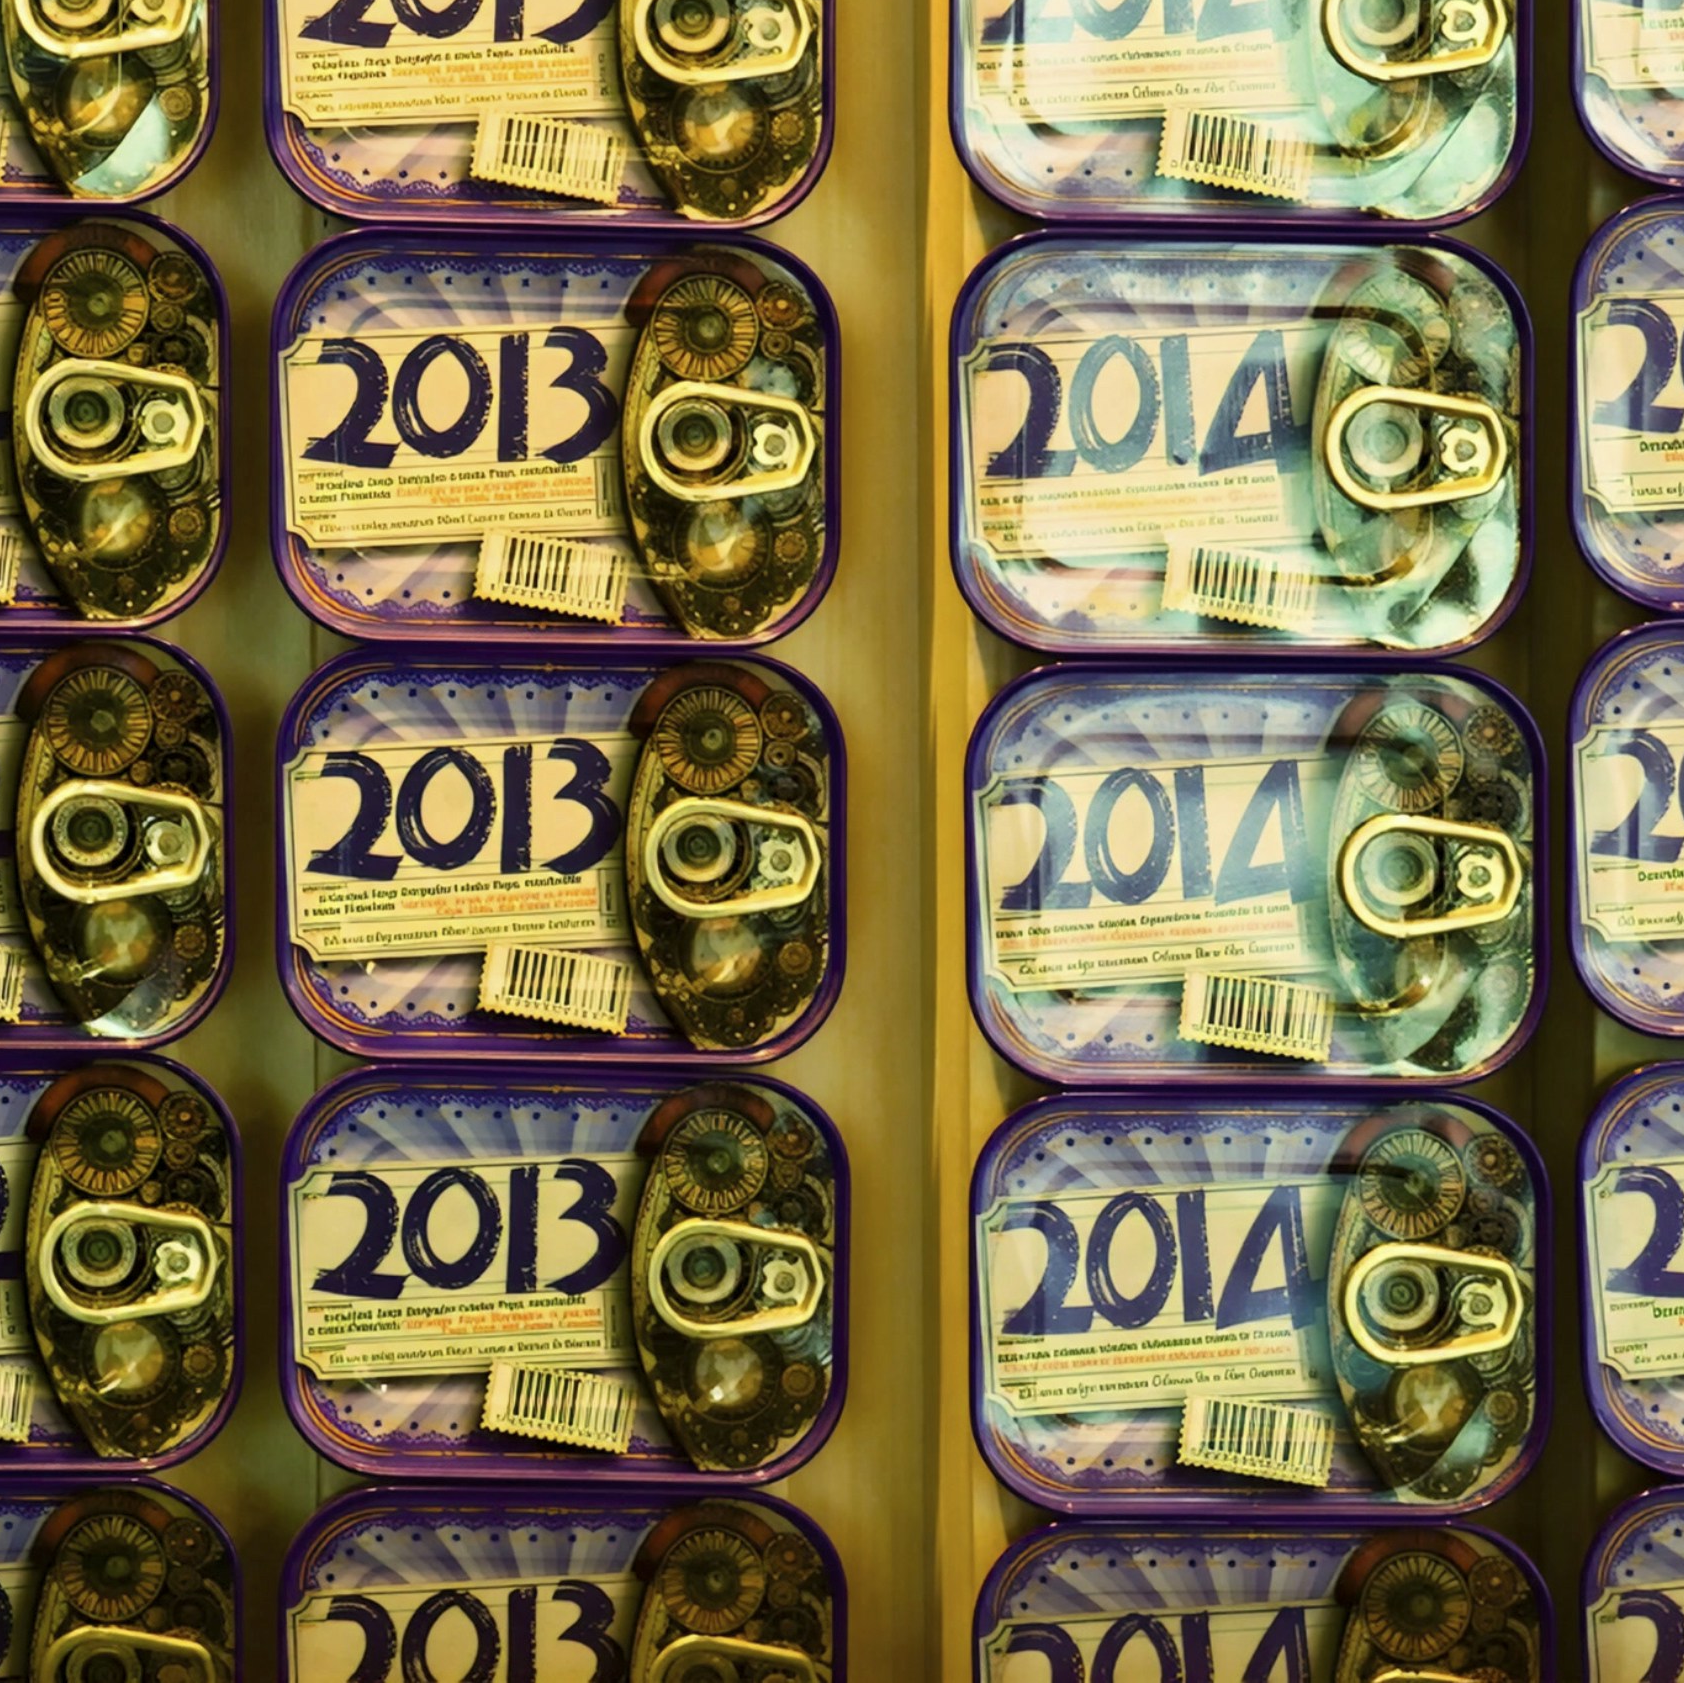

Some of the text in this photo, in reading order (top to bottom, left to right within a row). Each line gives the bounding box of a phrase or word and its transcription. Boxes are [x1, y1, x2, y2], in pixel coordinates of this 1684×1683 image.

[300, 326, 619, 467] 2013
[975, 331, 1309, 479] 2014
[308, 738, 620, 878] 2013
[998, 759, 1318, 908] 2014
[311, 1161, 628, 1301] 2013
[1002, 1184, 1325, 1333] 2014
[322, 1583, 622, 1683] 2013
